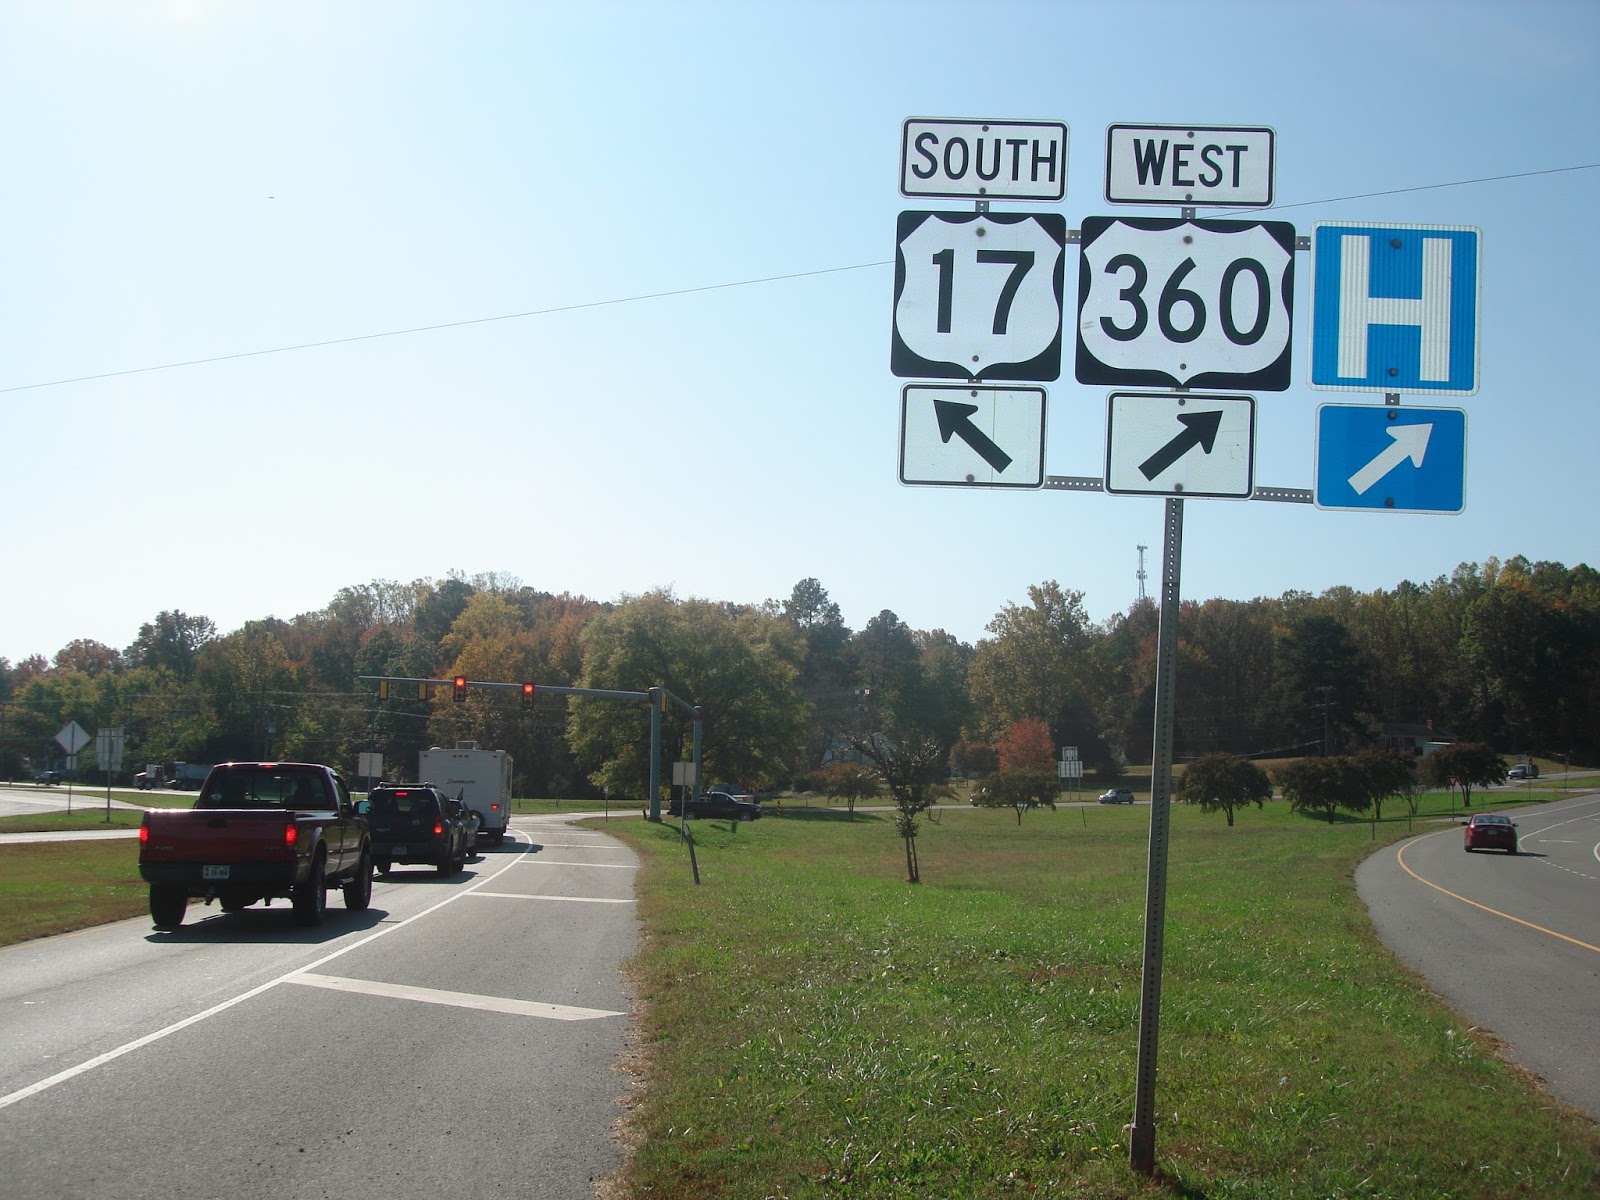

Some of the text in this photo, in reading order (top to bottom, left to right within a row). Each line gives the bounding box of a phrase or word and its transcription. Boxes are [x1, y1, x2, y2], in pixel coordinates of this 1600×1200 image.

[912, 132, 1057, 183] SOUTH
[1134, 139, 1249, 188] WEST
[933, 249, 1035, 335] 17
[1100, 254, 1271, 346] 360
[1338, 235, 1452, 381] H
